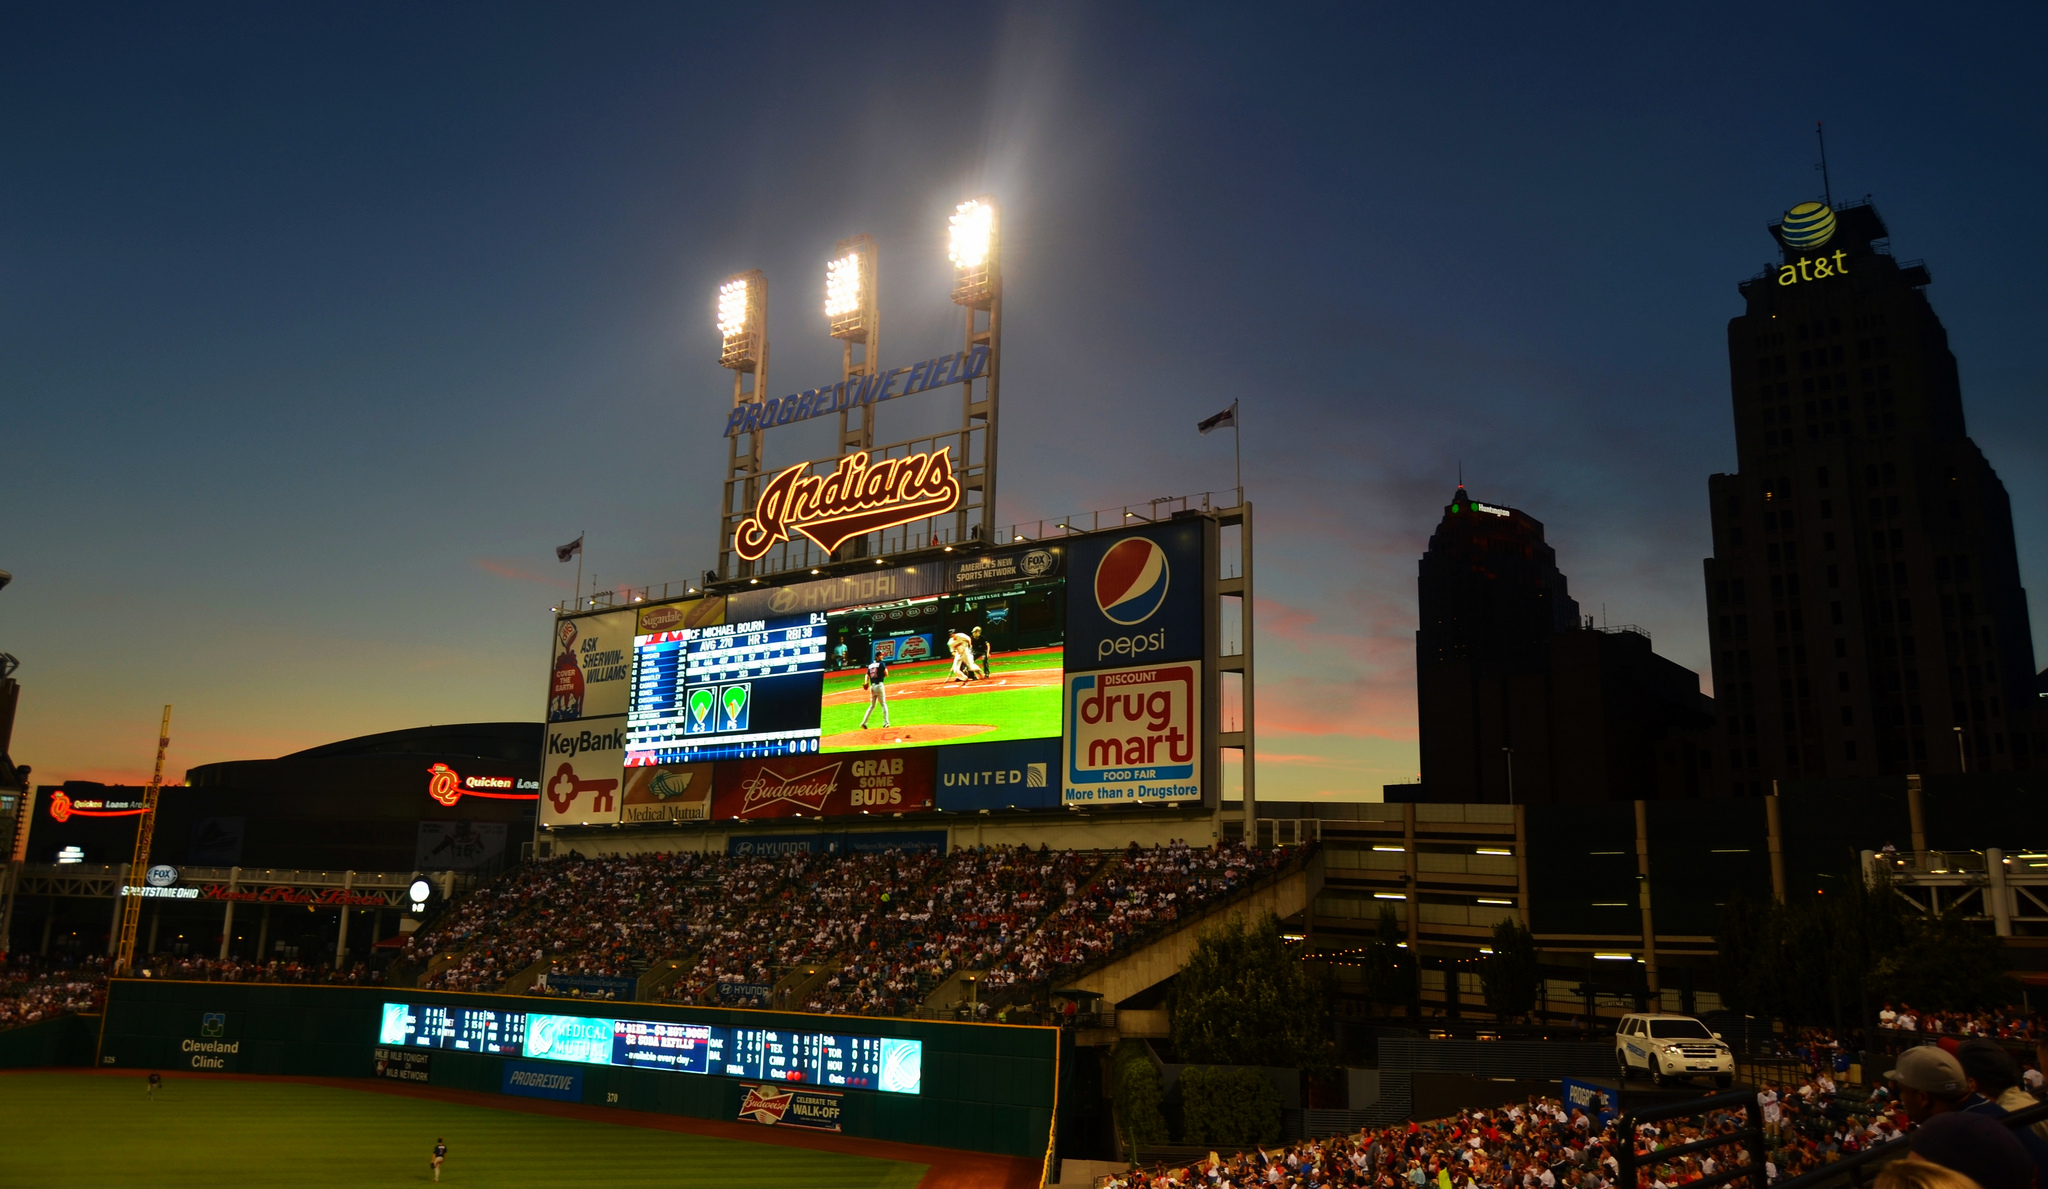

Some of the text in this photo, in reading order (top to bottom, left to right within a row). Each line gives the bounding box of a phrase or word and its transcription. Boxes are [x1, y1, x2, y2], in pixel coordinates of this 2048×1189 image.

[1779, 249, 1849, 286] at&t
[724, 346, 991, 438] PROGRESSIVE FIELD
[735, 446, 960, 561] Indians
[960, 558, 1013, 572] AMERICA'S NEW
[1028, 555, 1045, 566] FOX
[956, 566, 1016, 582] SPORTS NETWORK
[805, 576, 896, 606] HYUNDAI
[642, 611, 682, 629] Sugardale
[810, 612, 826, 624] B-L
[690, 620, 766, 640] CF MICHAEL BOURN
[786, 627, 812, 640] RBI 38
[580, 637, 598, 654] ASK
[700, 641, 716, 652] AVG
[718, 638, 734, 649] .270
[748, 632, 768, 646] HR 5
[1098, 628, 1165, 661] pepsi
[582, 650, 624, 668] SHERWIN-
[556, 669, 576, 678] COVER
[586, 664, 628, 684] WILLIAMS
[1105, 672, 1157, 686] DISCOUNT
[555, 684, 574, 692] EARTH
[1081, 676, 1171, 732] drug
[692, 722, 706, 732] 4-3
[549, 728, 624, 758] KeyBank
[789, 740, 797, 753] 0
[800, 740, 807, 752] 0
[811, 738, 818, 752] 0
[1088, 726, 1186, 767] mart
[852, 758, 904, 777] GRAB
[1103, 769, 1156, 780] FOOD FAIR
[465, 776, 512, 788] Quicken
[859, 775, 894, 788] SOME
[943, 770, 1022, 787] UNITED
[431, 771, 462, 805] Q
[742, 778, 838, 802] Budweiser
[1066, 784, 1198, 800] More than a Drugstore
[850, 787, 902, 806] BUDS
[74, 800, 129, 809] Quicken Loans
[626, 804, 705, 822] Medical Mutual
[154, 869, 170, 878] FOX
[518, 1035, 523, 1043] 0
[556, 1024, 607, 1040] MEDICAL
[737, 1031, 761, 1042] R H E
[766, 1032, 777, 1042] 4th
[182, 1039, 240, 1054] Cleveland
[638, 1035, 659, 1046] SODA
[661, 1037, 694, 1049] REFILLS
[710, 1038, 761, 1051] OAK 2 4 0
[792, 1035, 818, 1046] R H E
[823, 1036, 835, 1046] 5th
[852, 1039, 879, 1050] R H E
[374, 1049, 389, 1059] MLB
[555, 1039, 607, 1058] MUTUAL
[770, 1044, 818, 1056] TEX 0 3 0
[828, 1048, 878, 1060] TOR 0 2
[191, 1055, 224, 1068] Clinic
[390, 1051, 429, 1063] MLB TONIGHT
[629, 1050, 689, 1066] available every day
[747, 1054, 752, 1063] 5
[792, 1058, 798, 1067] 0
[812, 1059, 817, 1068] 0
[386, 1068, 429, 1081] MLB NETWORK
[726, 1064, 744, 1075] FINAL
[771, 1068, 786, 1079] Outs
[827, 1061, 878, 1074] HOU 7 6 0
[510, 1070, 574, 1091] PROGRESSIVE
[829, 1074, 845, 1084] Outs
[607, 1092, 618, 1103] 370
[741, 1095, 790, 1110] Budweiser
[796, 1096, 826, 1106] CELEBRATE
[793, 1104, 840, 1119] WALK-OFF
